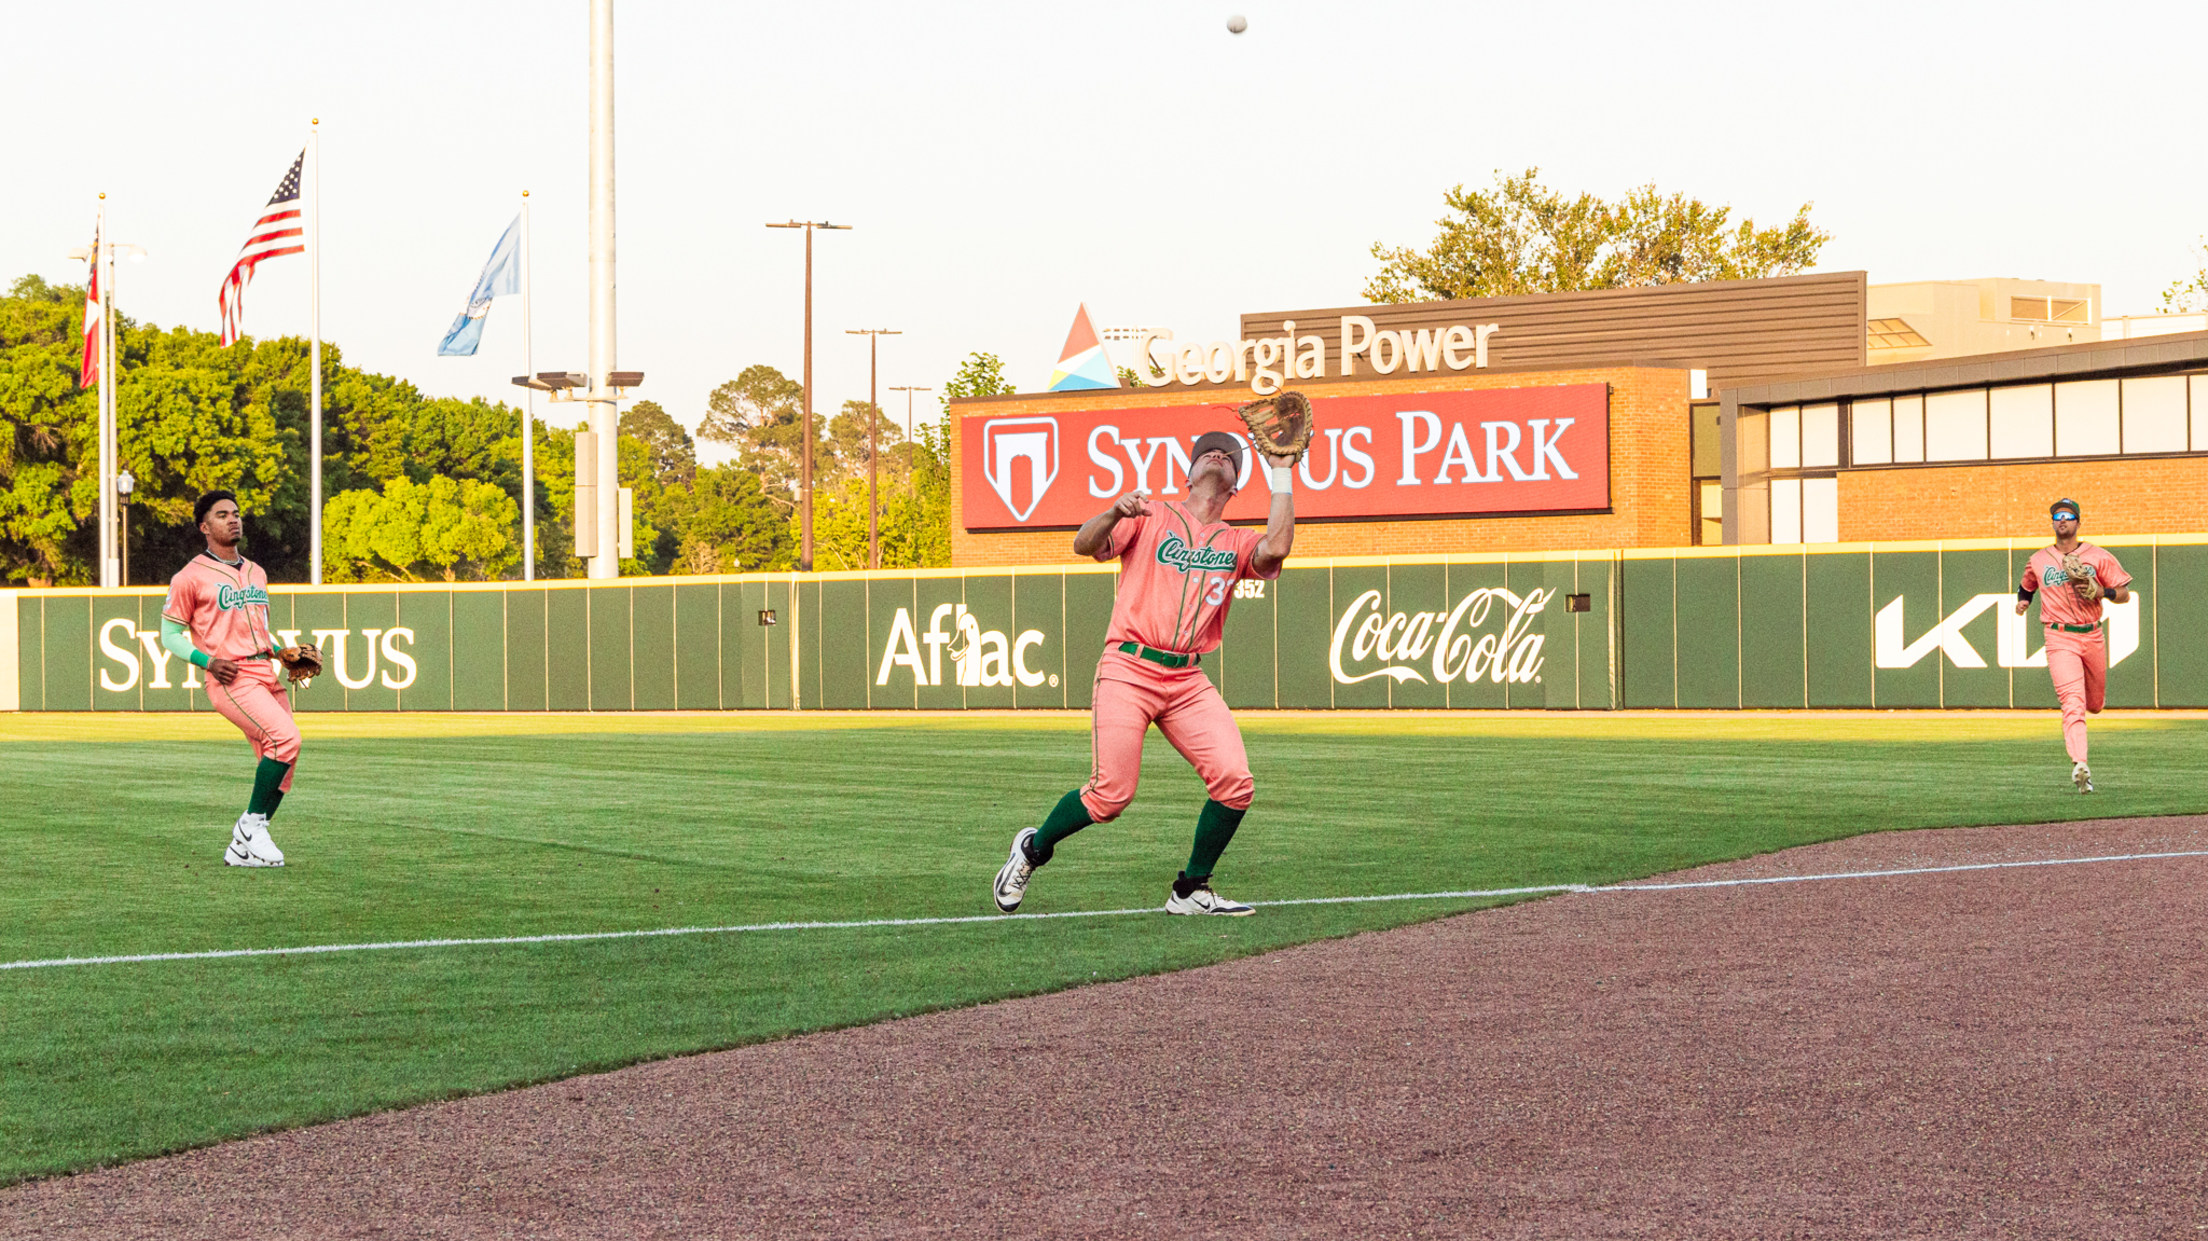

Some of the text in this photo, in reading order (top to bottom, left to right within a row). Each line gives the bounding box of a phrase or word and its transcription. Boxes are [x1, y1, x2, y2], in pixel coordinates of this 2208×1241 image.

[1138, 315, 1499, 395] Georgia Power
[1395, 410, 1579, 486] PARK
[1233, 579, 1265, 598] 352
[98, 618, 417, 692] SYUS
[875, 603, 1046, 687] Aflac
[1329, 587, 1556, 685] Coca-Cola
